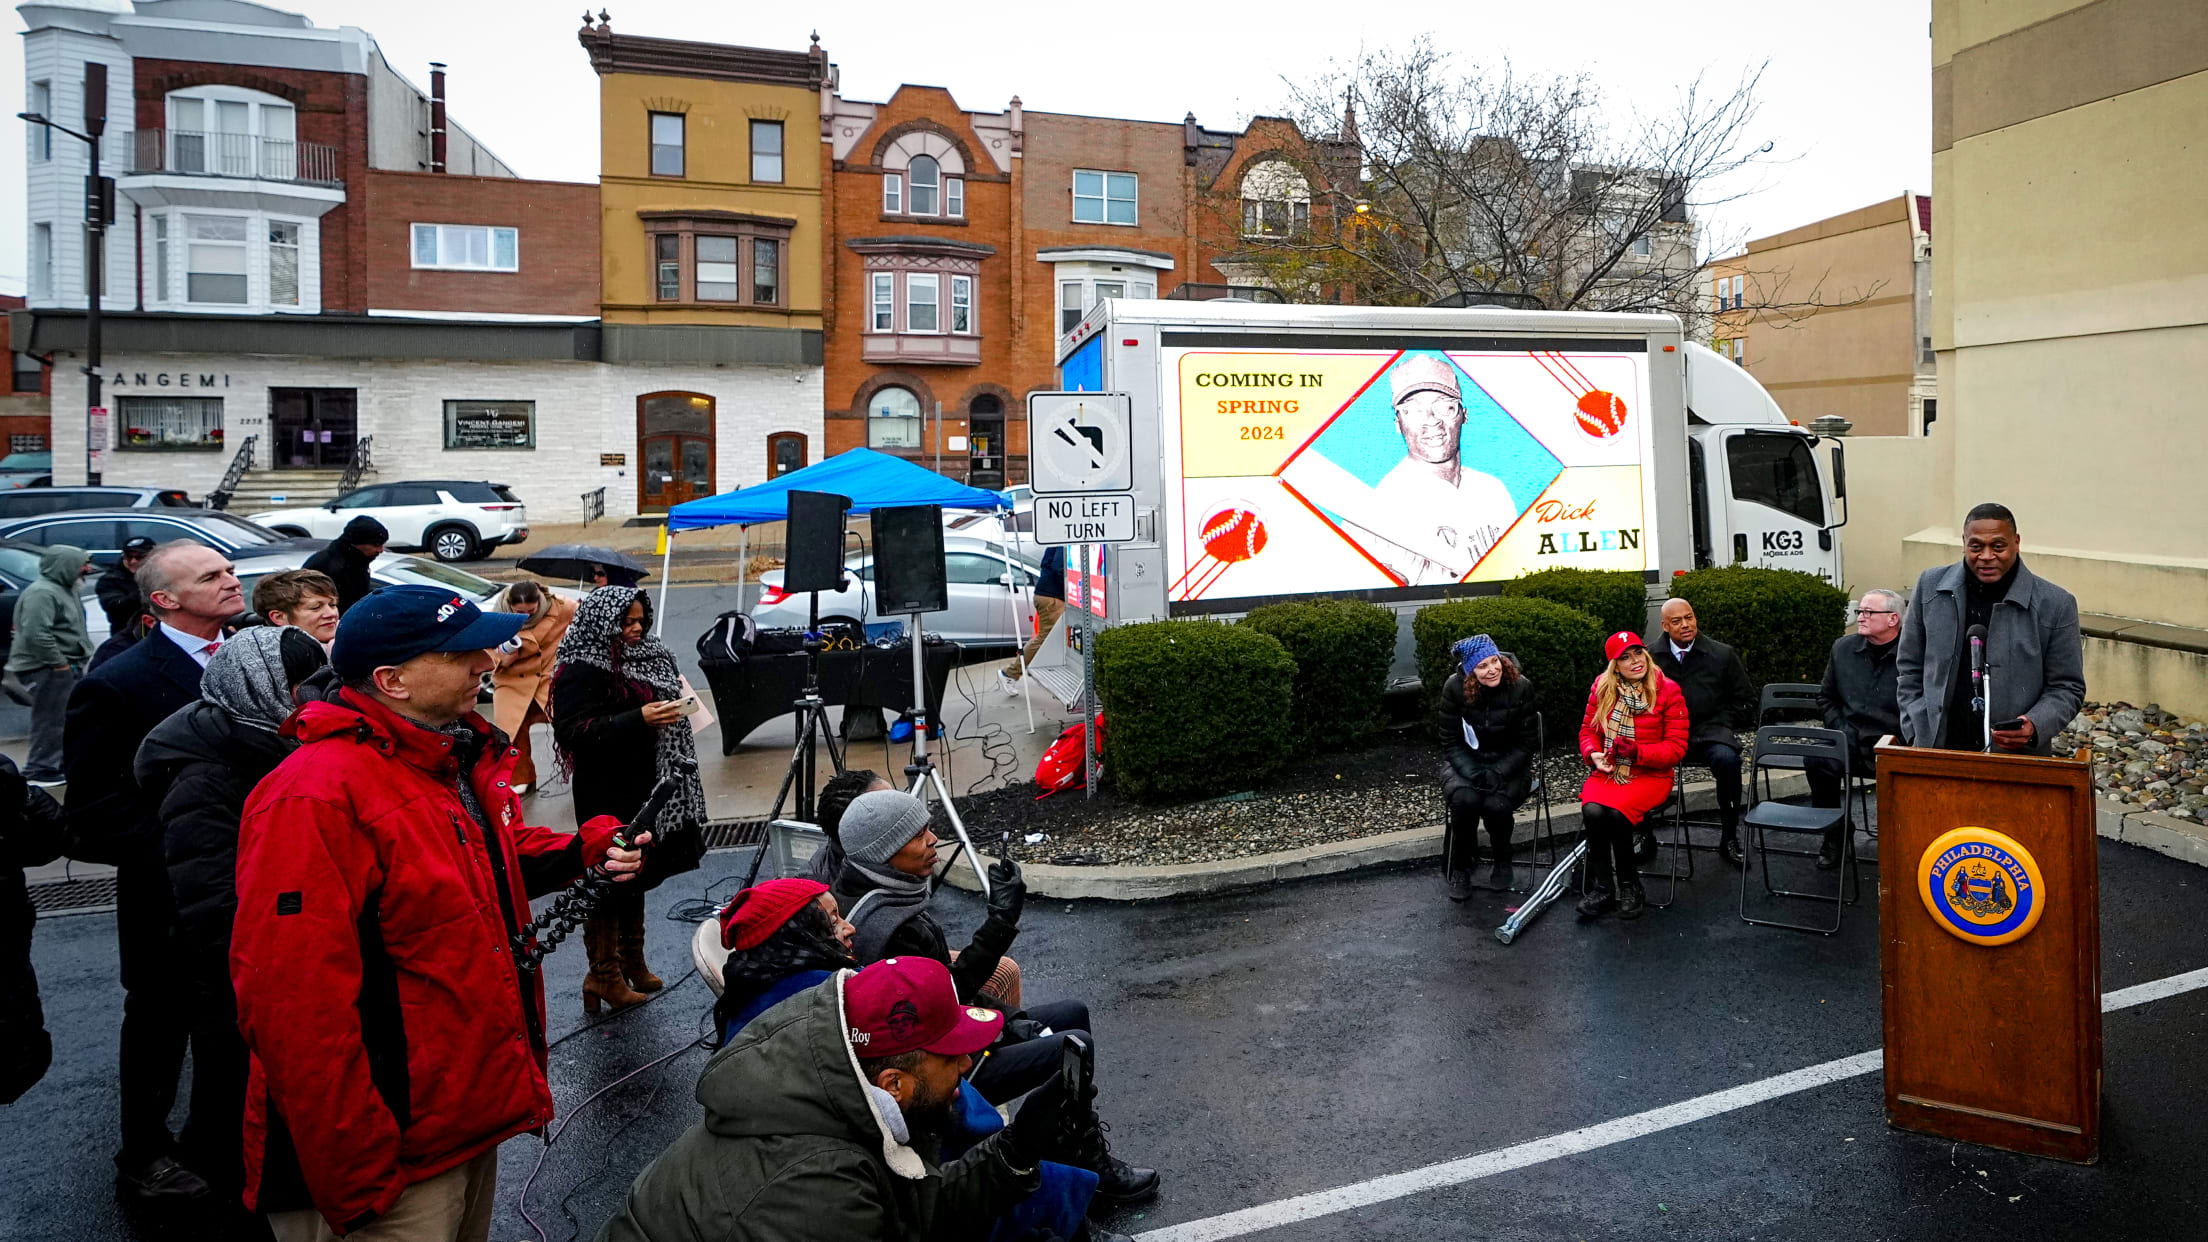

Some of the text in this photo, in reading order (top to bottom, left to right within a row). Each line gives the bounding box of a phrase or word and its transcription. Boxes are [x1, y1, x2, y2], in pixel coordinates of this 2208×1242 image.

[100, 373, 230, 387] ANGEMI
[1196, 373, 1323, 387] COMING IN
[1217, 400, 1299, 414] SPRING
[1240, 426, 1285, 440] 2024
[1048, 501, 1119, 519] NO LEFT
[1535, 499, 1597, 523] Dick
[1064, 523, 1105, 539] TURN
[1537, 528, 1641, 555] ALLEN
[1762, 530, 1803, 550] KG3
[1762, 550, 1789, 558] MOBILE
[1931, 845, 2030, 891] PHILADELPHIA
[850, 1027, 871, 1046] Roy
